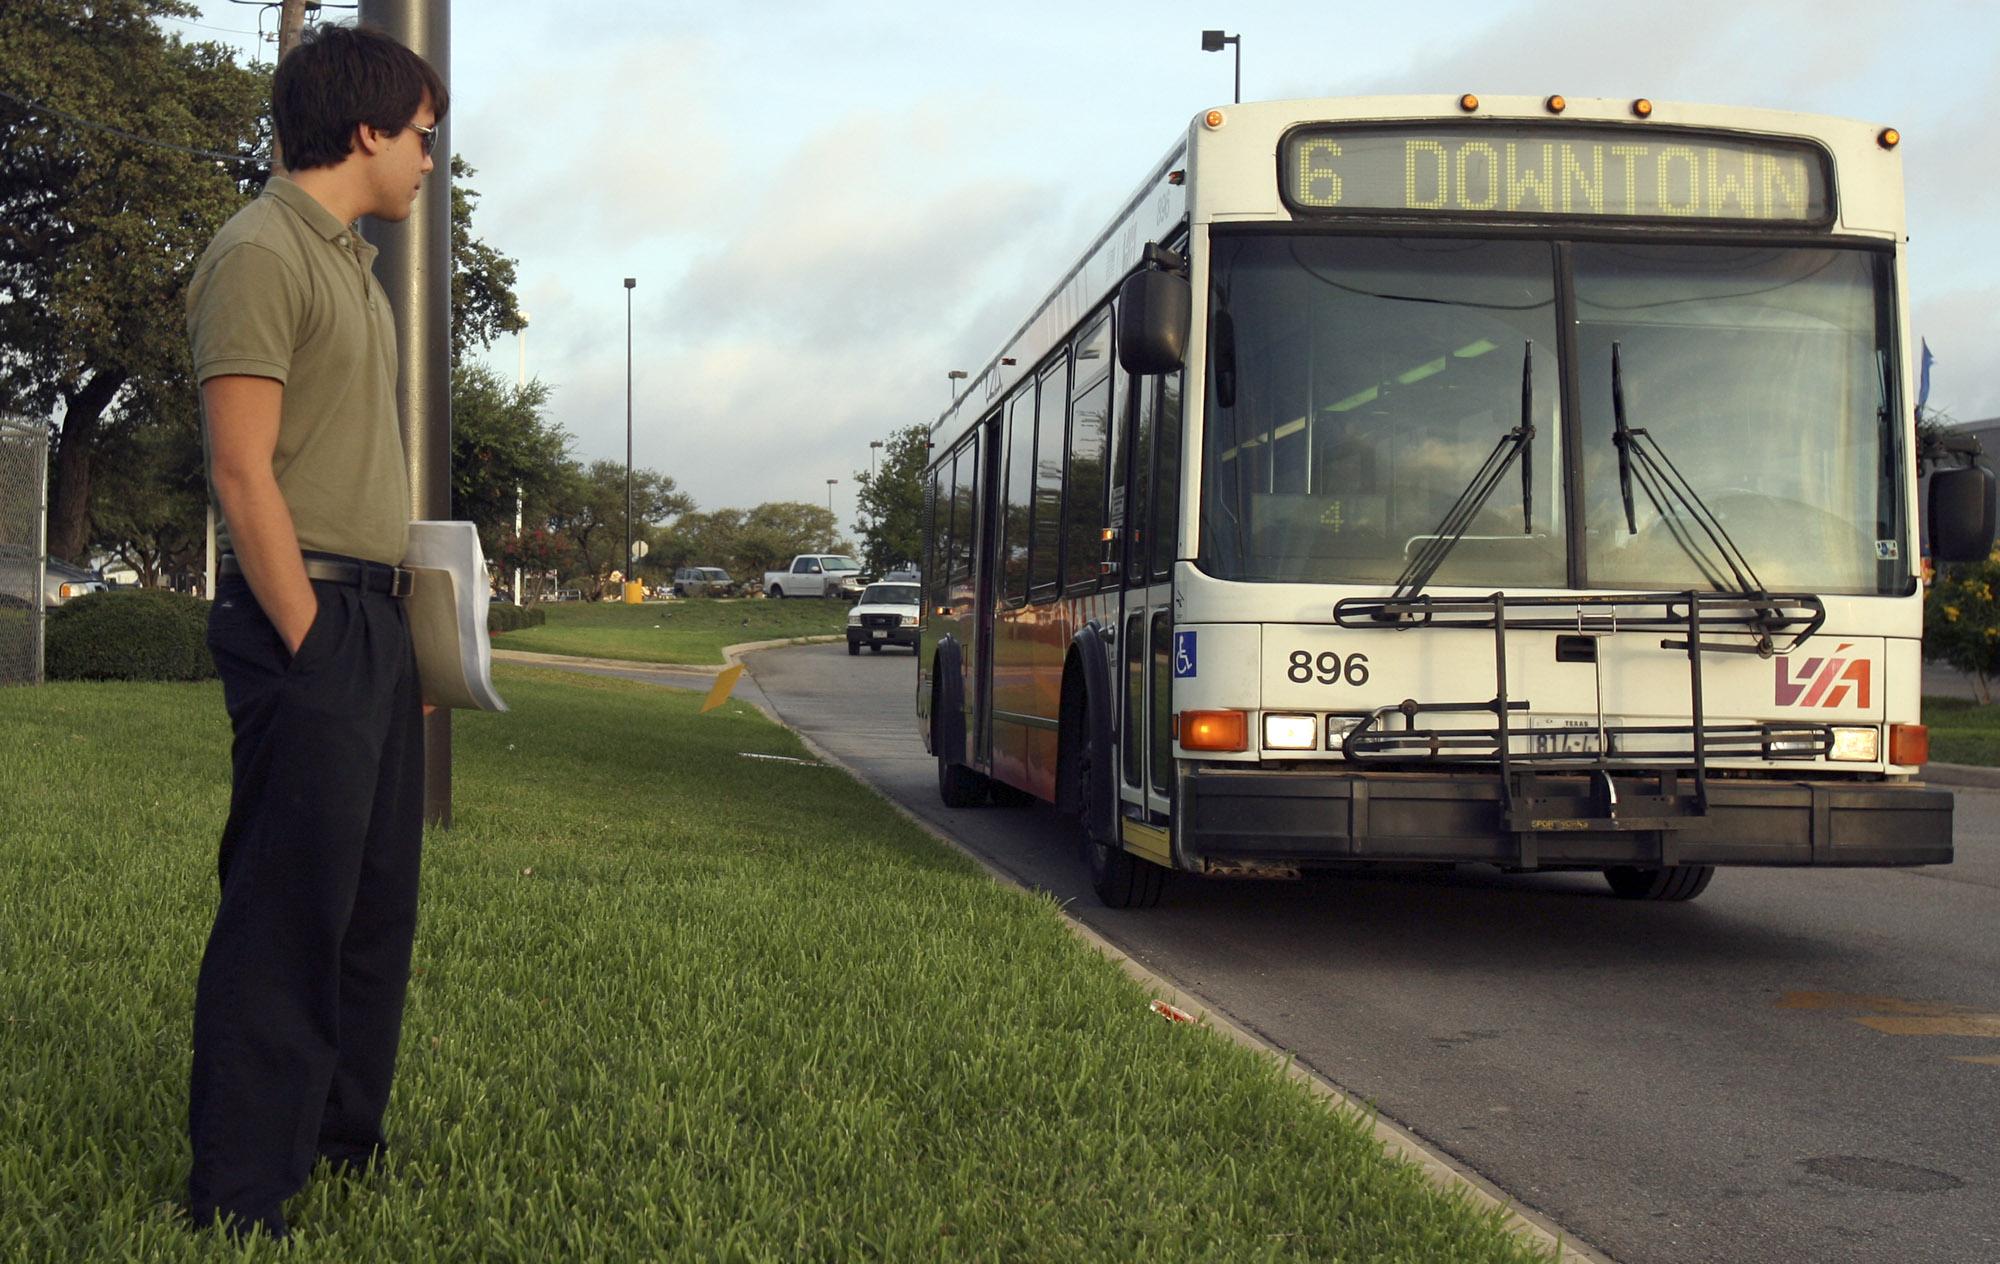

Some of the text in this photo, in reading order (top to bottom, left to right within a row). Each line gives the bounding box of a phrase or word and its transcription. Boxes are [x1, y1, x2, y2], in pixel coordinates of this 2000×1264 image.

[1300, 138, 1808, 219] 6 DOWNTOWN
[1287, 650, 1369, 686] 896
